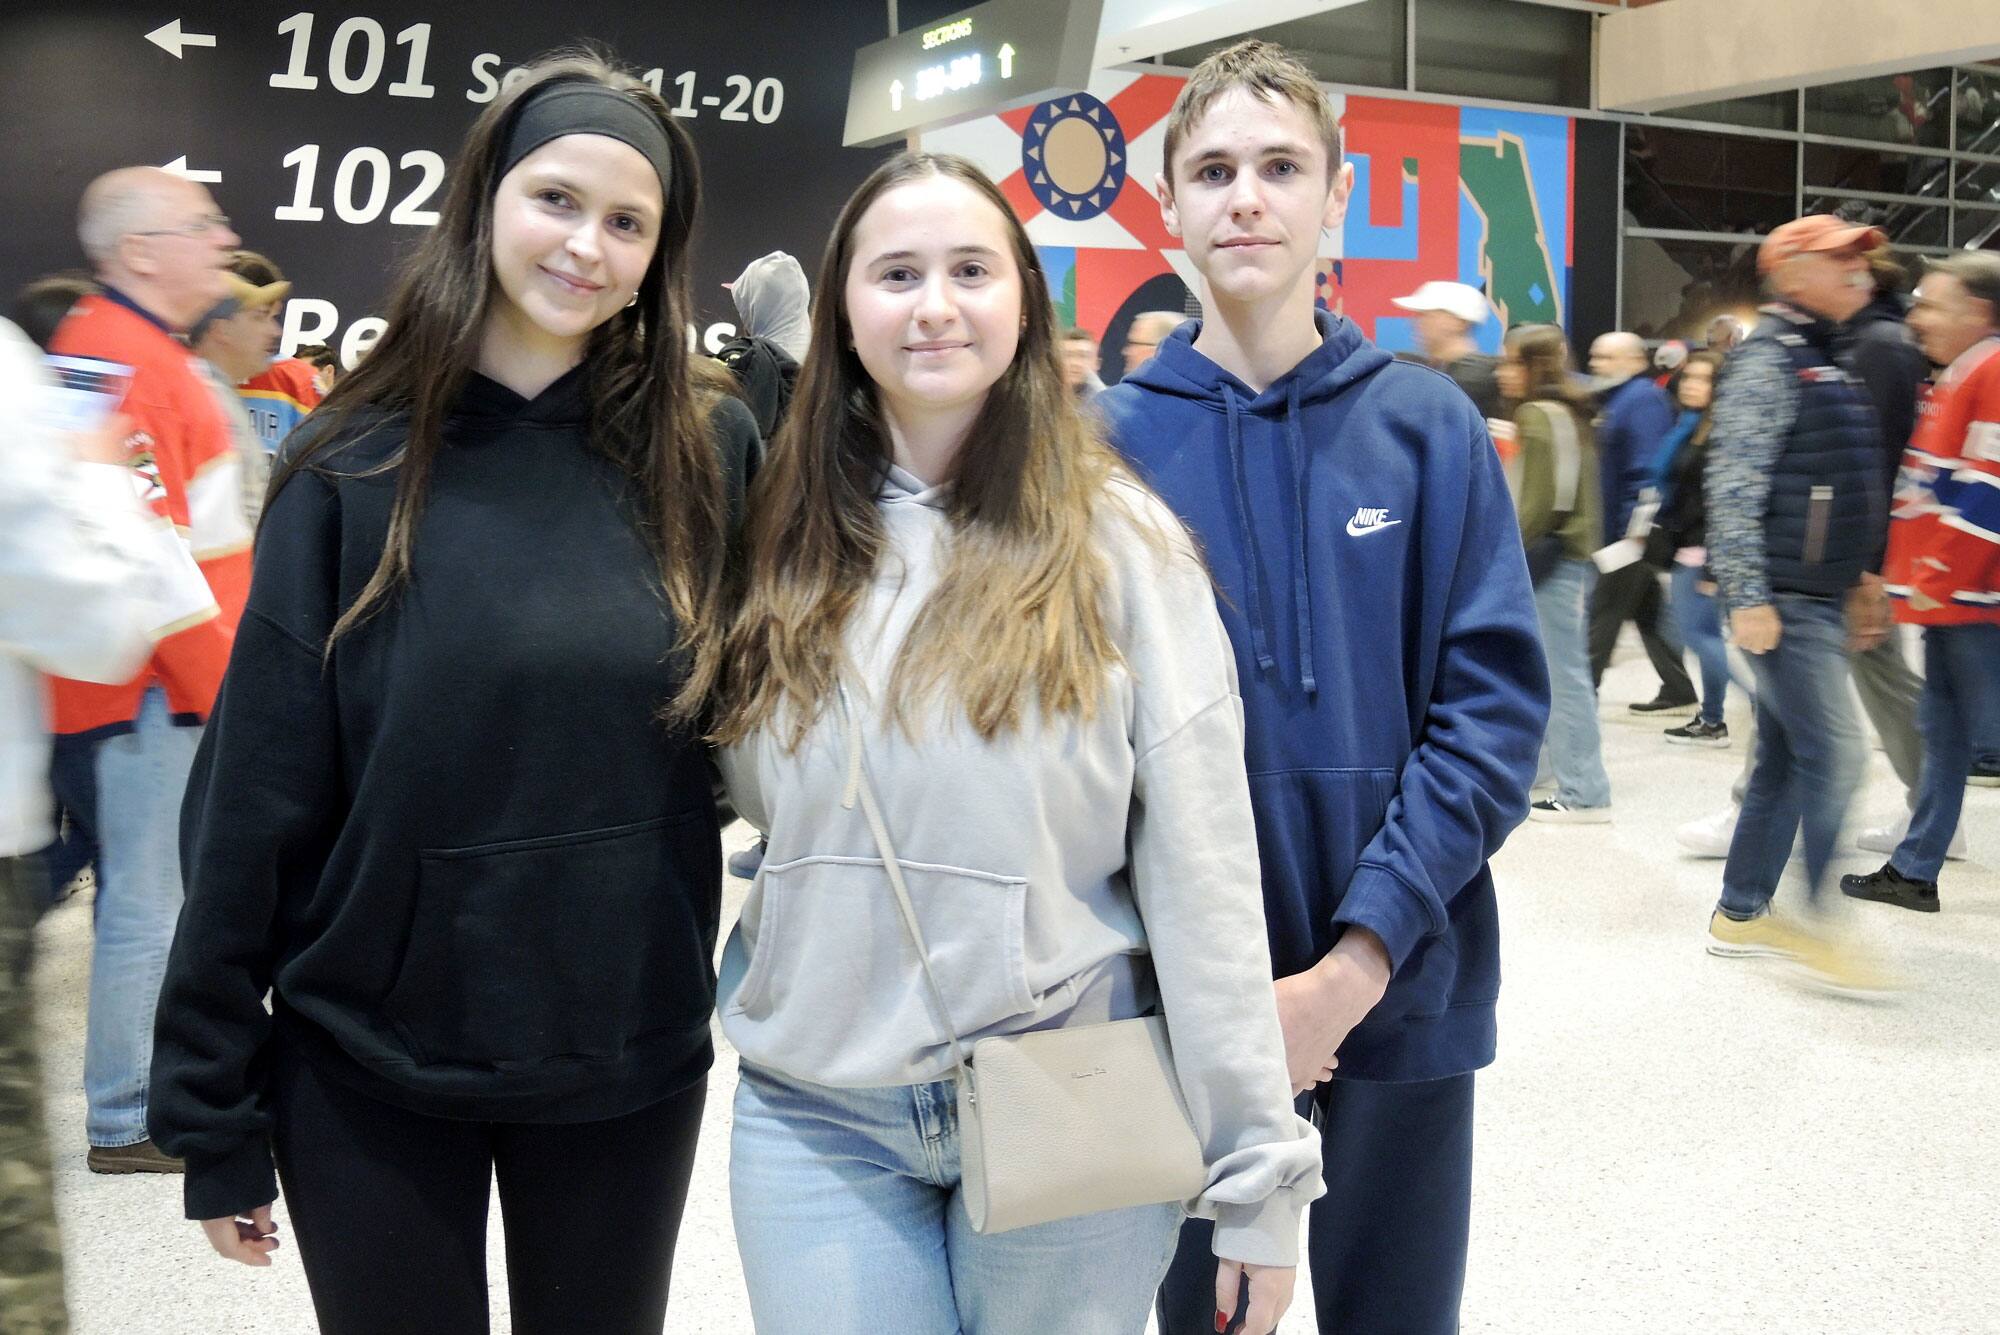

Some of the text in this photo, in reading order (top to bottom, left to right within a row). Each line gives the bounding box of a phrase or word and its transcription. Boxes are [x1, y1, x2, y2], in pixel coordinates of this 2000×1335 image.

[269, 12, 436, 98] 101
[275, 144, 446, 226] 102
[1354, 507, 1389, 526] NIKE
